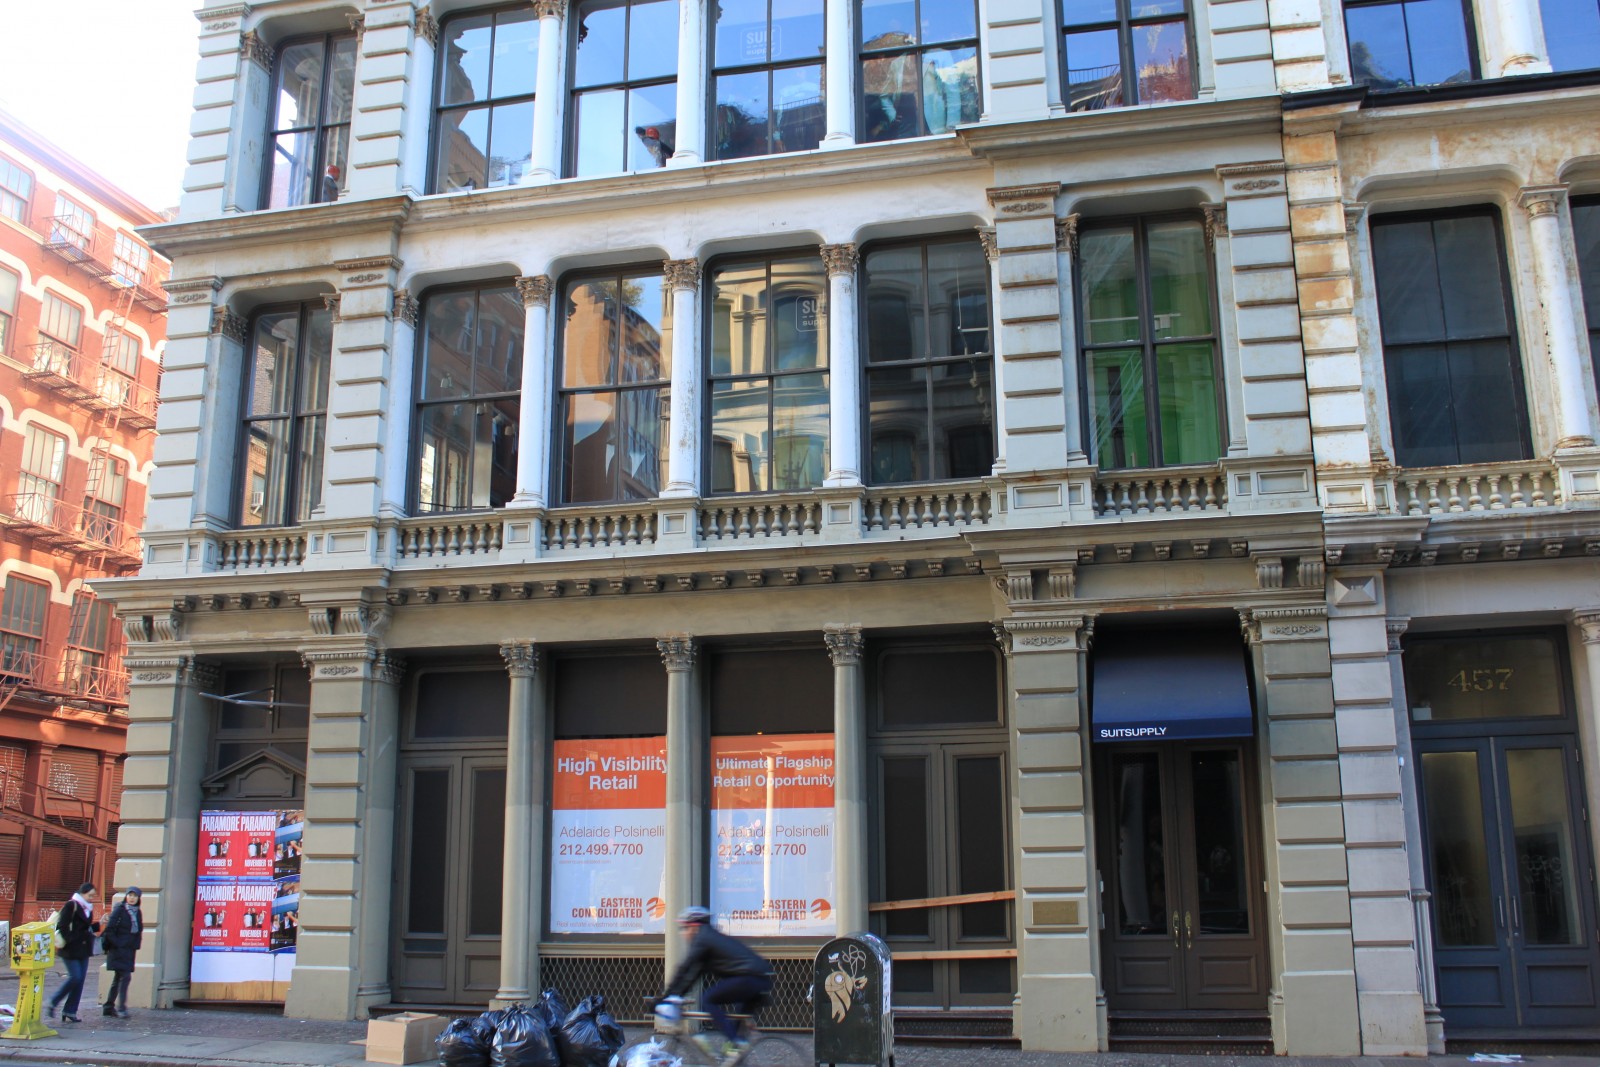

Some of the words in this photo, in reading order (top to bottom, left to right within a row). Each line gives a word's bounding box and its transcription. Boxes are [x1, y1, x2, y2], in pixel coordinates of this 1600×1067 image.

[1447, 668, 1514, 691] 457
[1100, 727, 1167, 738] SUITSUPPLY
[558, 757, 596, 776] High
[600, 755, 668, 774] Visibility
[716, 757, 770, 770] Ultimate
[775, 755, 833, 771] Flagship
[589, 774, 638, 790] Retail
[713, 775, 751, 788] Retail
[201, 815, 240, 831] PARAMORE
[240, 815, 276, 831] PARAMOR
[560, 825, 610, 838] Adelaide
[614, 825, 665, 837] Polsinelli
[775, 825, 829, 838] Polsinelli
[560, 843, 643, 856] 212.499.7700
[204, 859, 227, 867] NOVEMBER
[244, 859, 267, 867] NOVEMBER
[197, 885, 236, 901] PARAMORE
[236, 885, 277, 901] PARAMORE
[600, 898, 643, 908] EASTERN
[572, 908, 643, 919] CONOLIDATED
[732, 910, 807, 920] CONSOLIDATED
[200, 929, 222, 937] NOVEMBER
[240, 930, 262, 938] NOVEMBER
